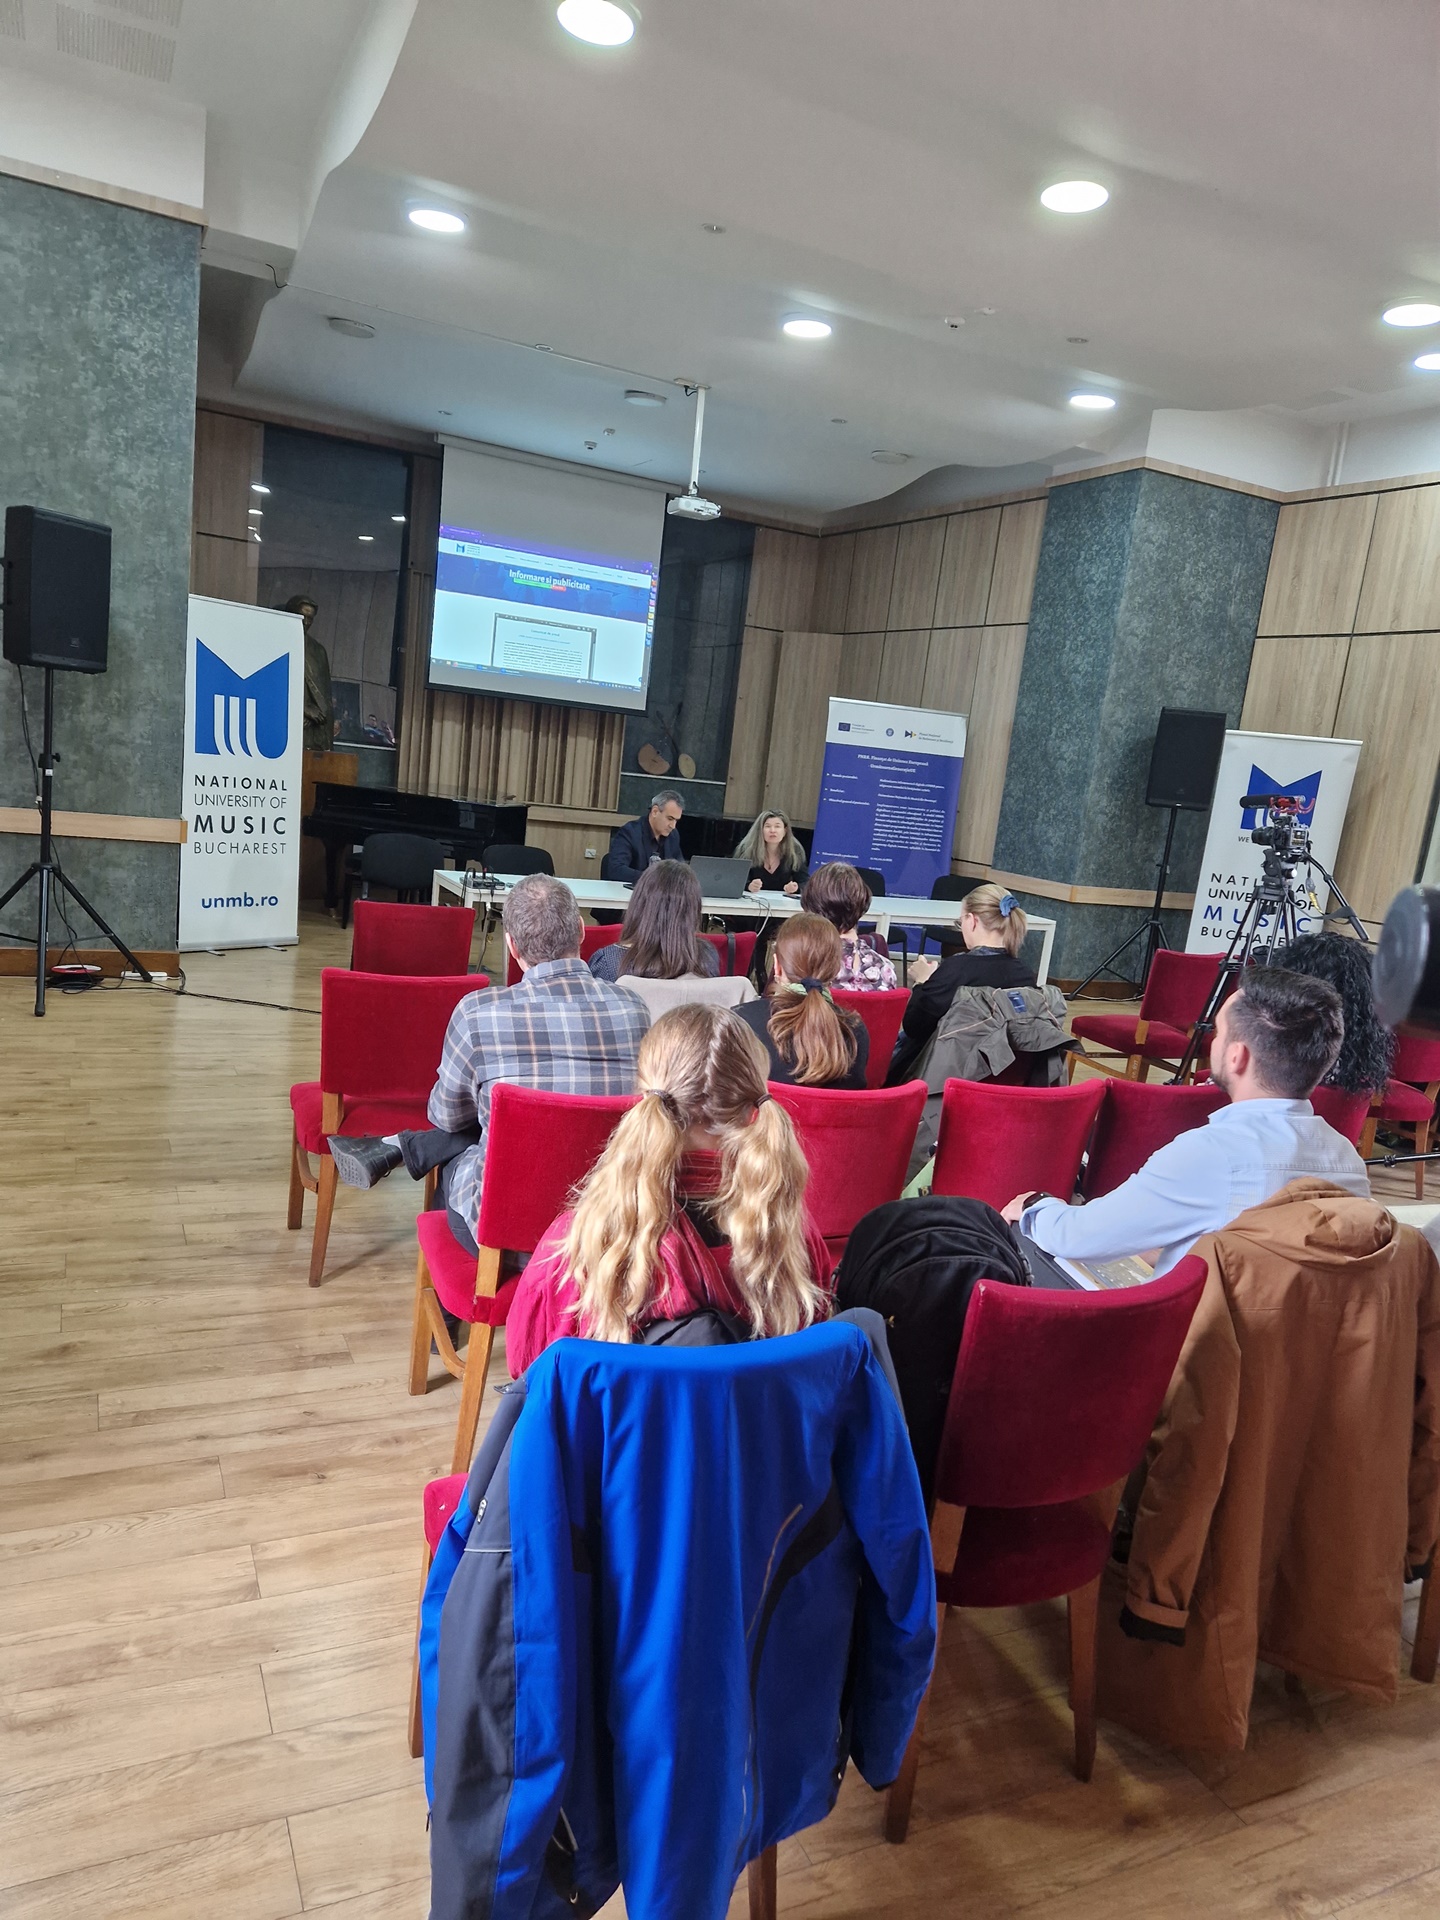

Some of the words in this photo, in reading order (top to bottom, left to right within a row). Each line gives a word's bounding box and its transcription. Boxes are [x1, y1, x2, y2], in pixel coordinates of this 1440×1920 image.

[509, 569, 546, 583] Informare
[552, 578, 591, 591] publicitate
[194, 774, 288, 791] NATIONAL
[194, 793, 266, 808] UNIVERSITY
[269, 796, 287, 809] OF
[194, 814, 286, 835] MUSIC
[194, 841, 287, 854] BUCHAREST
[1238, 836, 1250, 844] WE
[1210, 873, 1318, 896] NATIA
[201, 891, 279, 909] unmb.ro
[1200, 926, 1287, 947] BUCHARE
